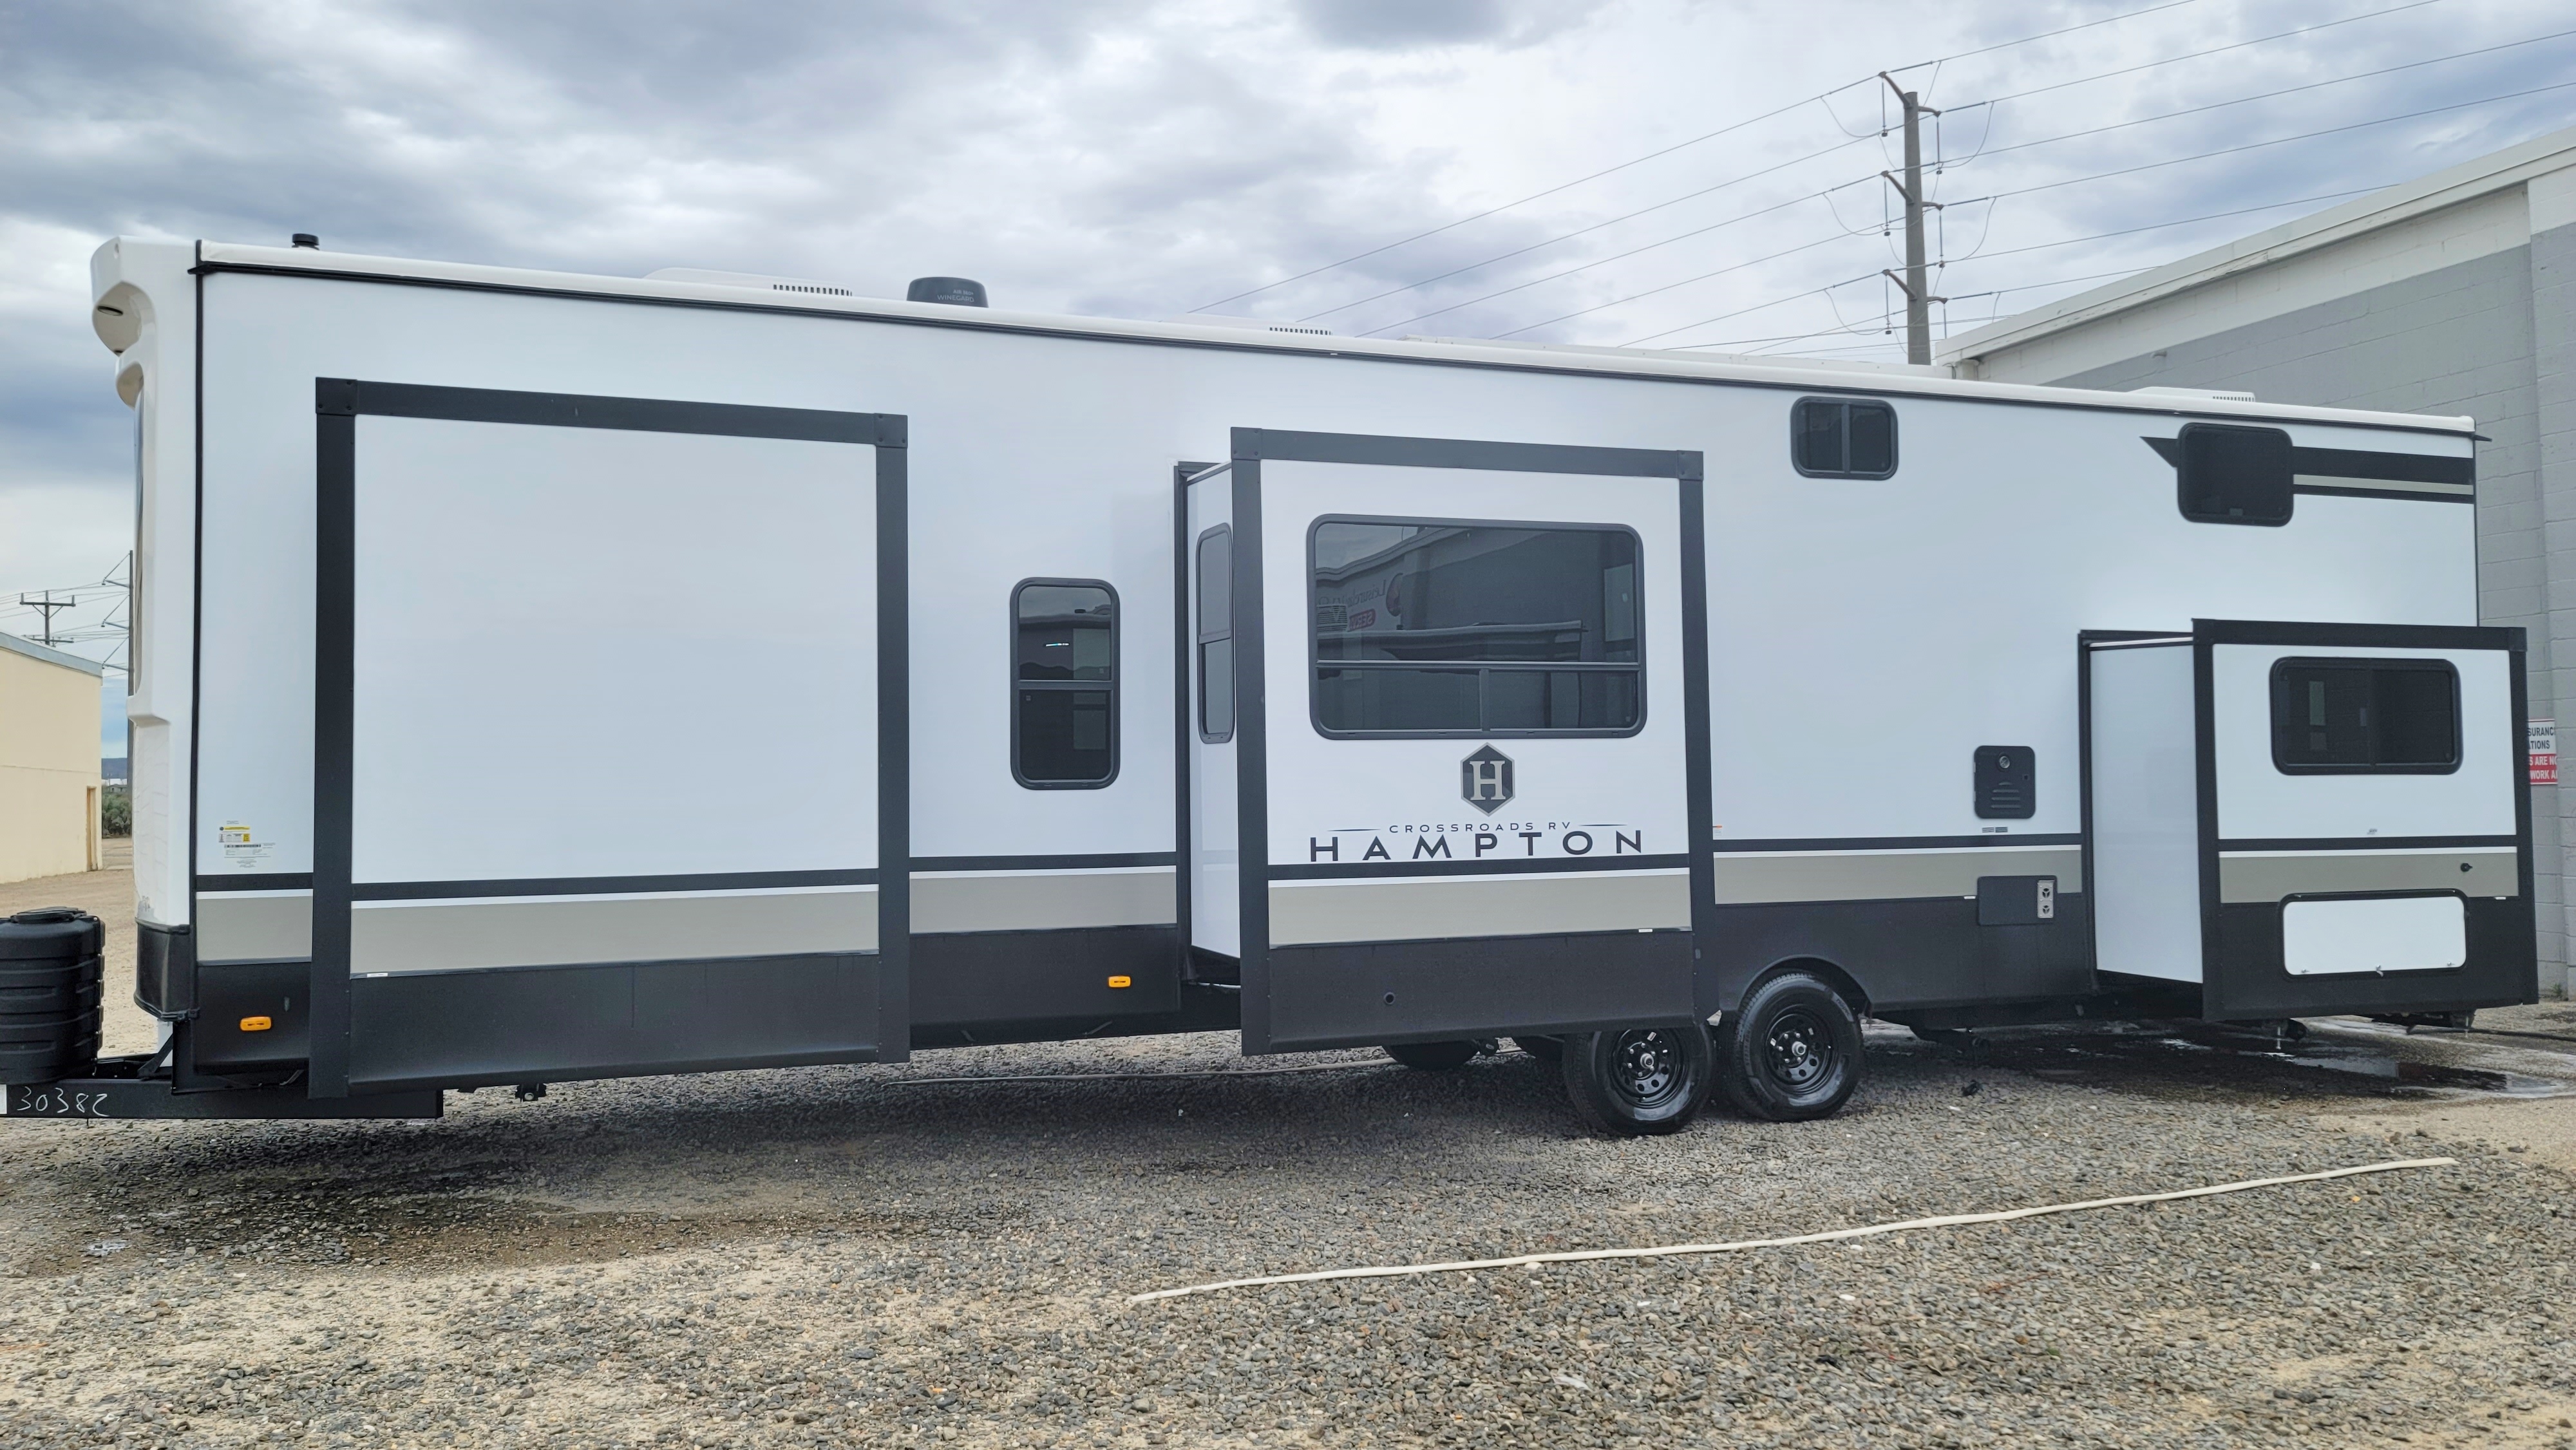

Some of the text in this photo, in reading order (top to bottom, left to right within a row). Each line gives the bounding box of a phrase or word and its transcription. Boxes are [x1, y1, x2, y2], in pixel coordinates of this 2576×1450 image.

[937, 294, 974, 303] WINEGARD
[2528, 726, 2556, 737] SURANC
[2528, 740, 2550, 749] TIONS
[2535, 756, 2548, 766] ARE
[2530, 769, 2550, 779] WORK
[1469, 760, 1506, 800] H
[1389, 822, 1571, 834] CROSSROADS RV
[1310, 829, 1642, 862] HAMPTON
[17, 1086, 110, 1117] 30382
